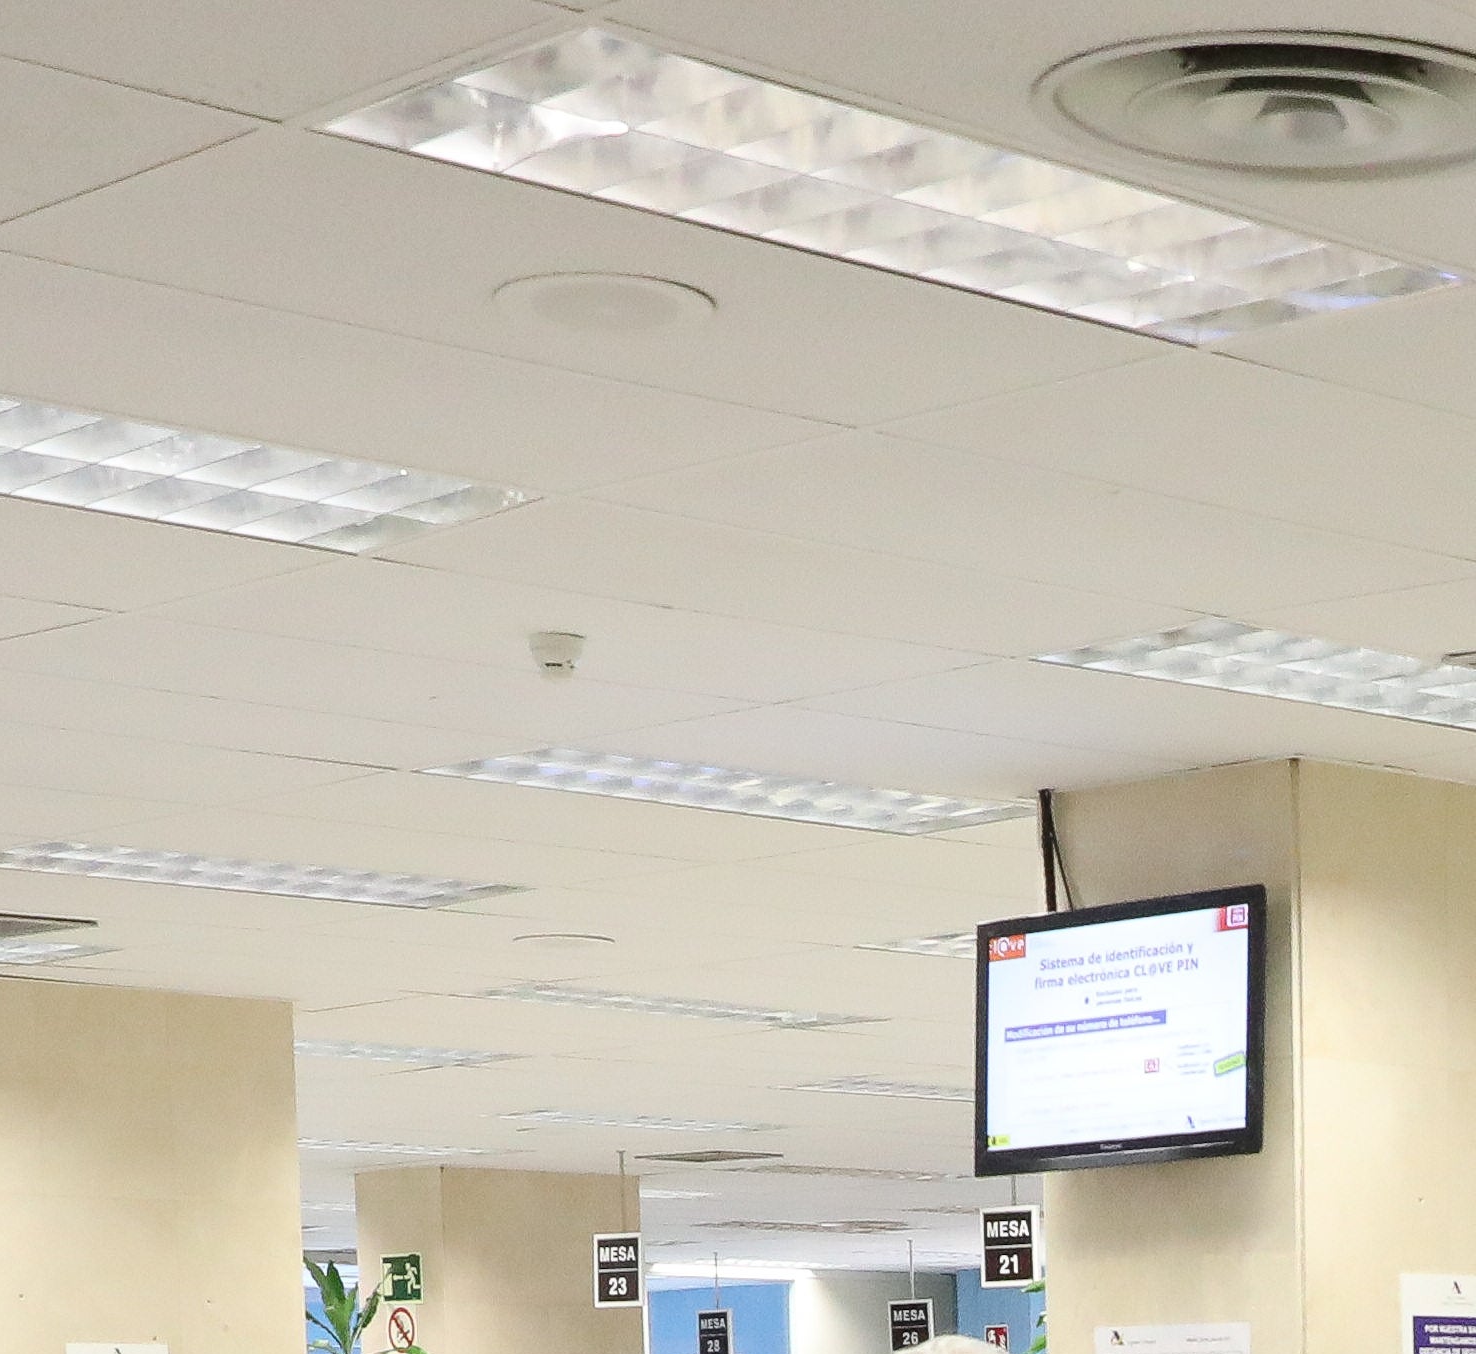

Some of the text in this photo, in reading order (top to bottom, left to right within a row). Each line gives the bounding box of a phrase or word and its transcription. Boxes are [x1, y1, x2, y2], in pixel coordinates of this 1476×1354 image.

[1039, 943, 1194, 971] Sistema de identificación y
[1035, 974, 1064, 990] firma
[1068, 968, 1130, 985] electrónica
[1177, 958, 1199, 972] PIN
[986, 1219, 1030, 1239] MESA
[599, 1245, 636, 1263] MESA
[999, 1254, 1019, 1274] 21
[608, 1276, 628, 1296] 23
[700, 1317, 726, 1330] MESA
[892, 1309, 926, 1322] MESA
[706, 1339, 721, 1353] 28
[902, 1331, 919, 1346] 26
